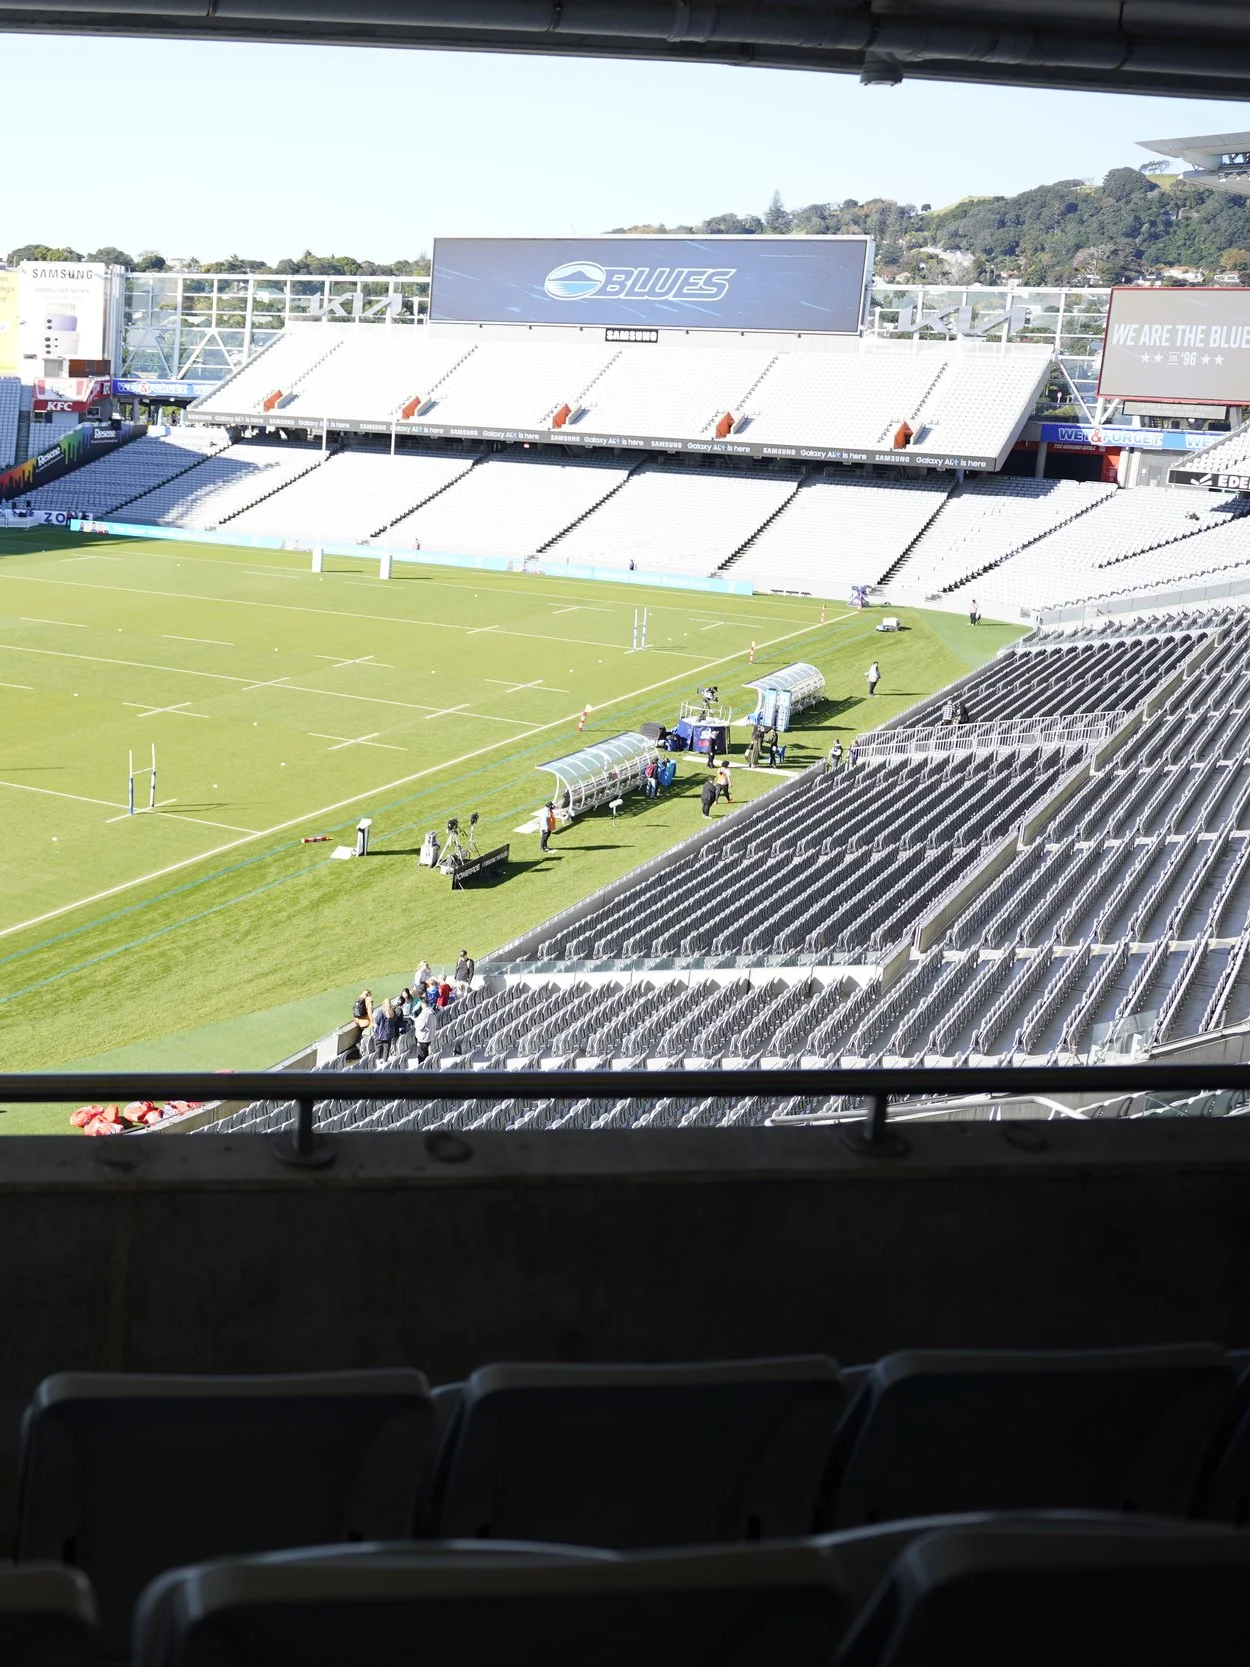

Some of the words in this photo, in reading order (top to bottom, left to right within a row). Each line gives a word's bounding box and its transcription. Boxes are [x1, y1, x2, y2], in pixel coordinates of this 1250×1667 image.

[32, 268, 93, 280] SAMSUNG
[603, 267, 737, 300] BLUES
[310, 292, 403, 316] KIA
[900, 304, 1032, 334] KIA
[606, 330, 658, 341] SAMSUNG
[1112, 323, 1139, 346] WE
[1139, 323, 1172, 347] ARE
[1175, 324, 1207, 348] THE
[47, 402, 73, 411] KFC
[94, 428, 116, 439] Resene
[450, 428, 478, 436] SAMSUNG
[482, 430, 505, 438] Galaxy
[524, 432, 539, 440] here
[550, 434, 580, 442] SAMSUNG
[584, 436, 608, 445] Galaxy
[628, 438, 644, 446] here
[1090, 427, 1103, 443] &
[1102, 431, 1163, 446] FORGET
[651, 440, 682, 448] SAMSUNG
[688, 442, 712, 451] Galaxy
[37, 446, 61, 467] Resene
[762, 447, 796, 456] SAMSUNG
[800, 450, 826, 459] Galaxy
[849, 452, 866, 460] here
[875, 454, 910, 462] SAMSUNG
[916, 456, 943, 466] Galaxy
[968, 460, 986, 468] here
[1217, 474, 1250, 489] EDE
